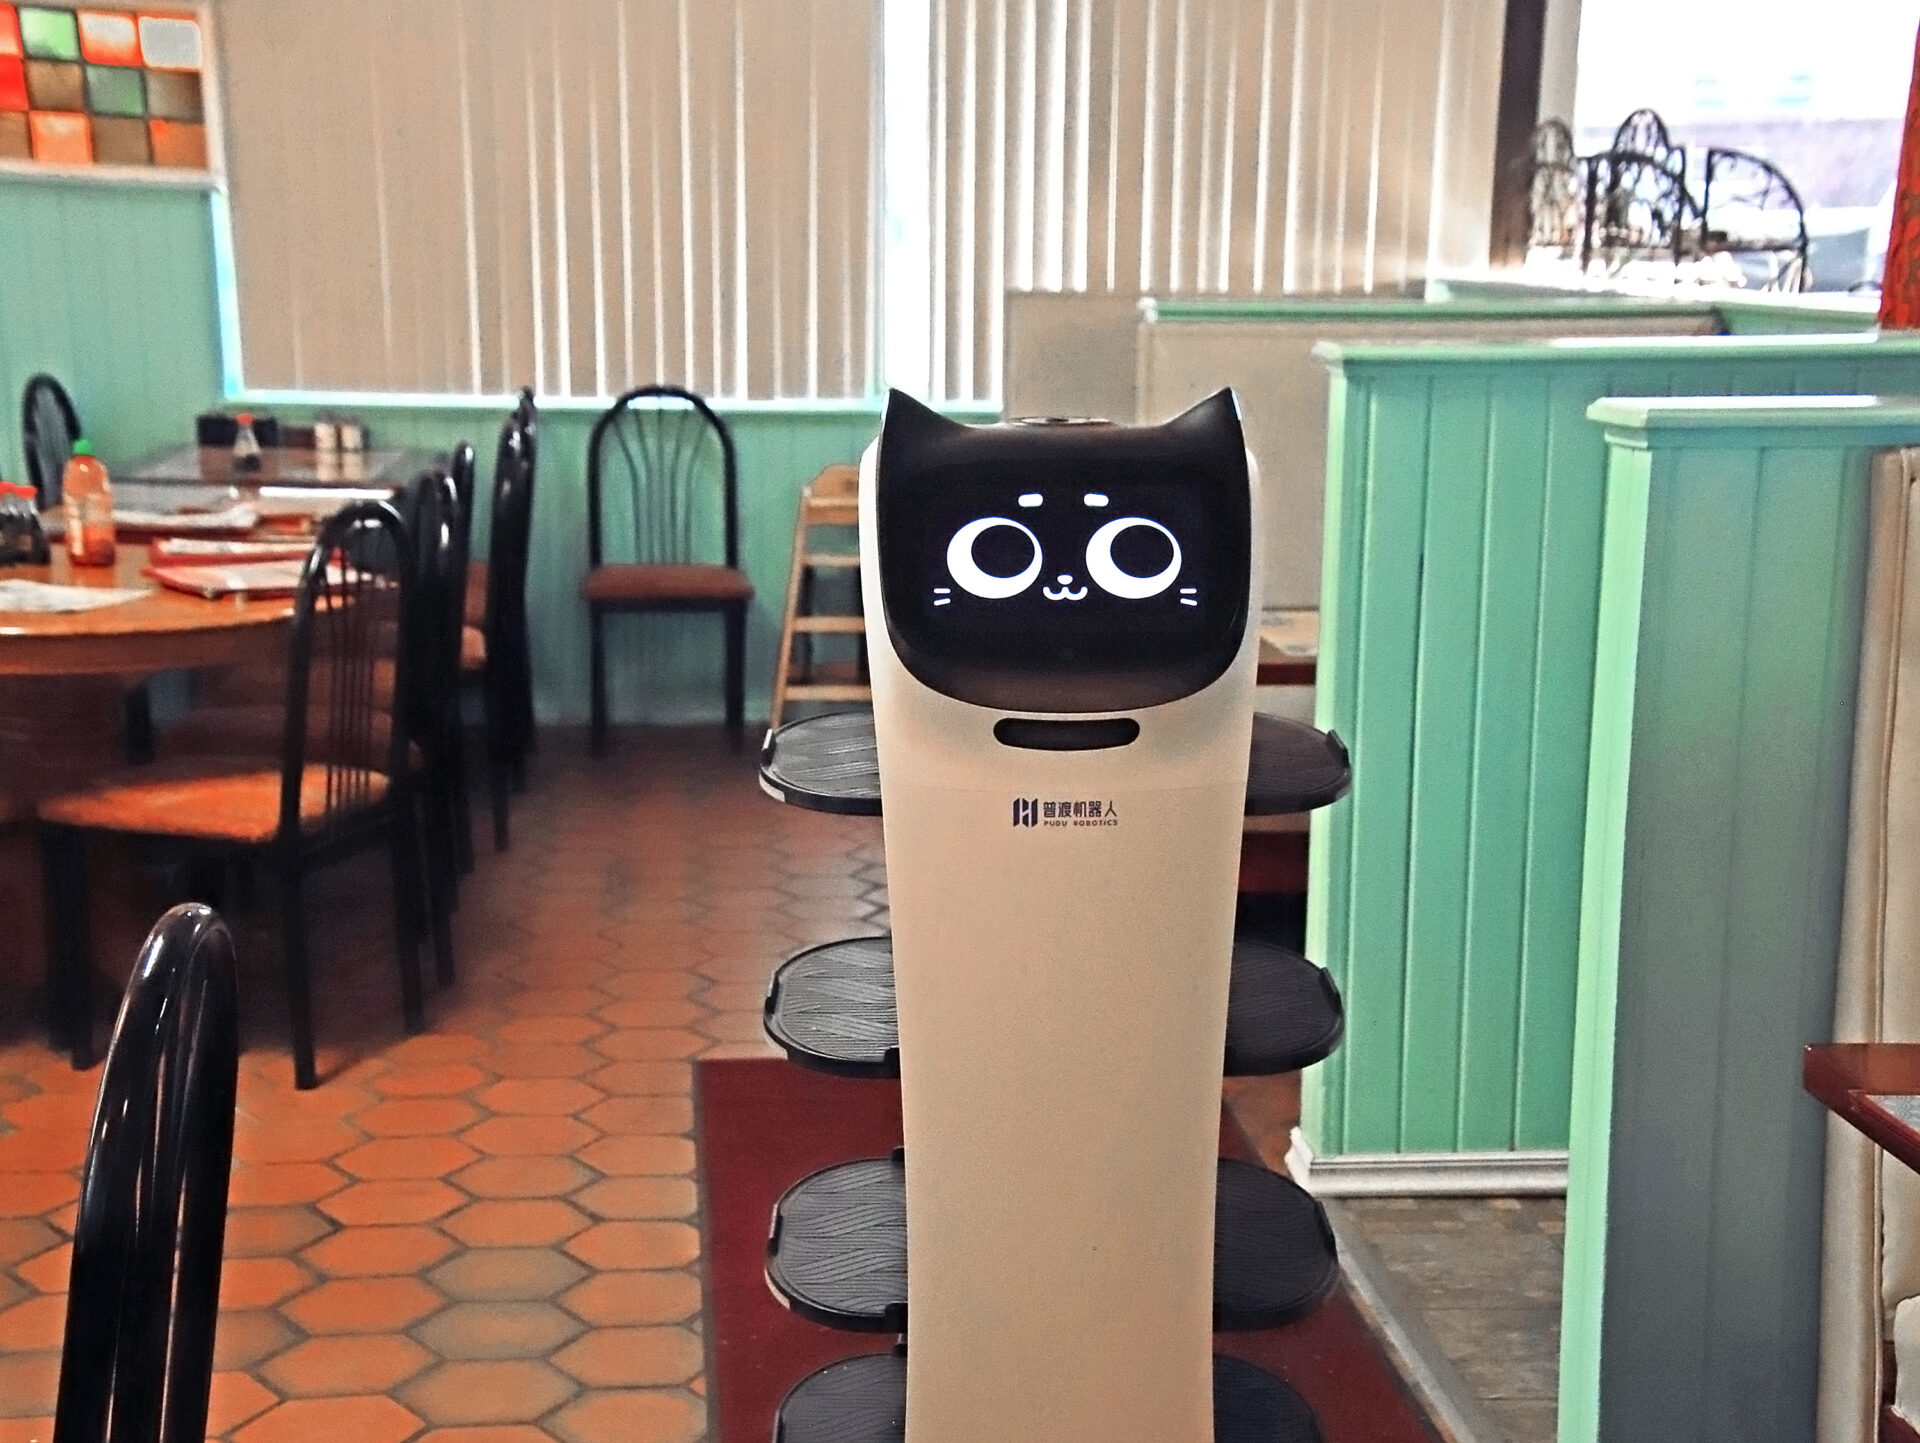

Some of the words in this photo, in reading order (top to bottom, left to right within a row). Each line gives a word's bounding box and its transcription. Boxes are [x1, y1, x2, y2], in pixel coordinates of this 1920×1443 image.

[1043, 800, 1117, 818] 普渡机器人
[1043, 819, 1068, 827] PUDU
[1073, 819, 1118, 827] ROBOTICS
